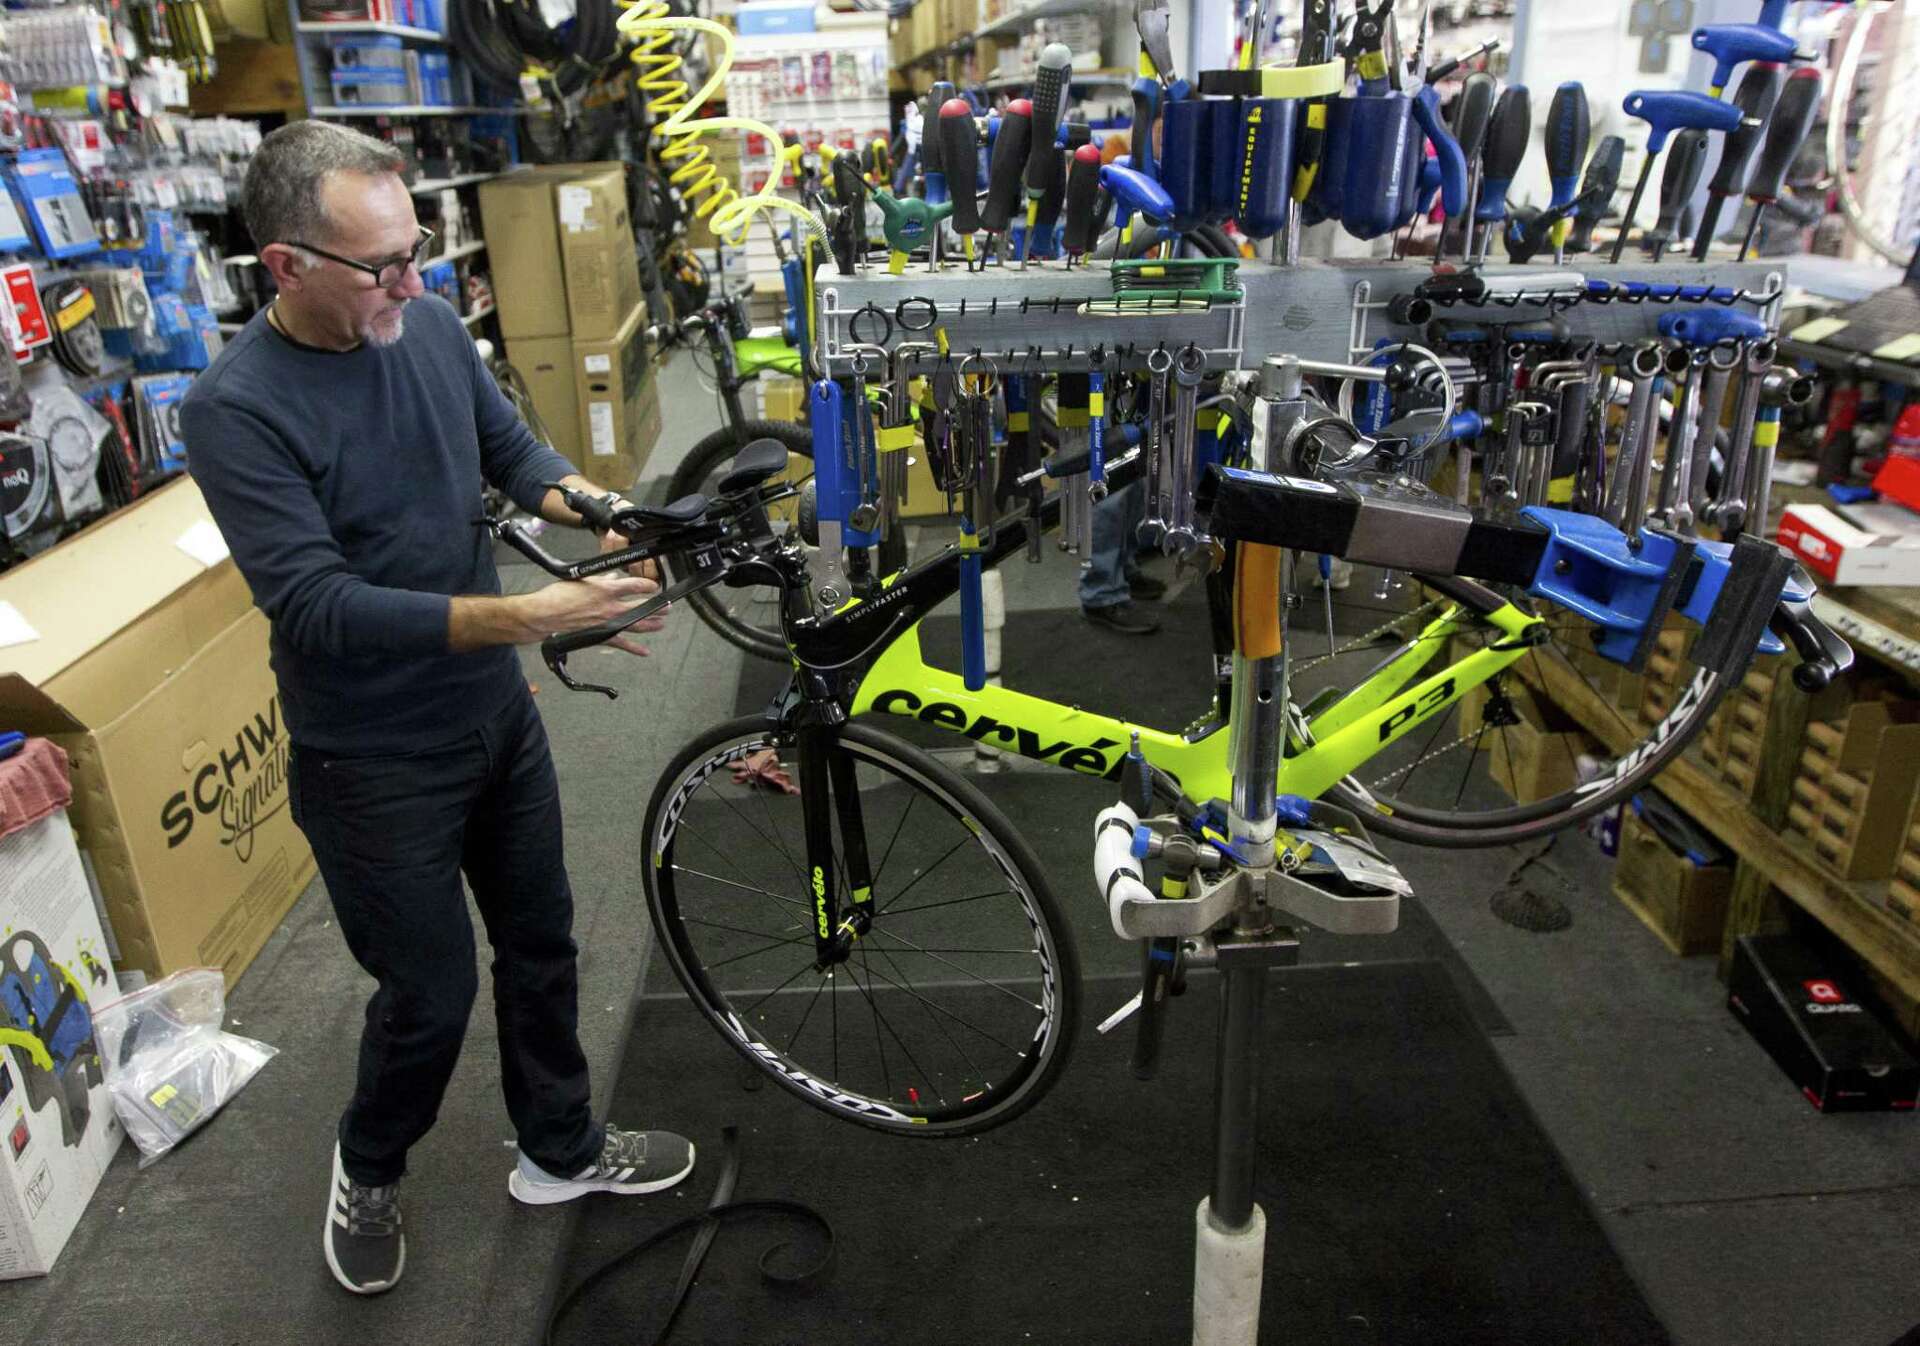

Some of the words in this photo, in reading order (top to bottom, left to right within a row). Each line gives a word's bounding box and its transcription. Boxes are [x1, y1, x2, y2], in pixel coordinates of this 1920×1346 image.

[696, 552, 712, 567] 3T
[870, 689, 1181, 787] cervé
[1379, 676, 1456, 743] P3
[811, 866, 829, 939] cervélo
